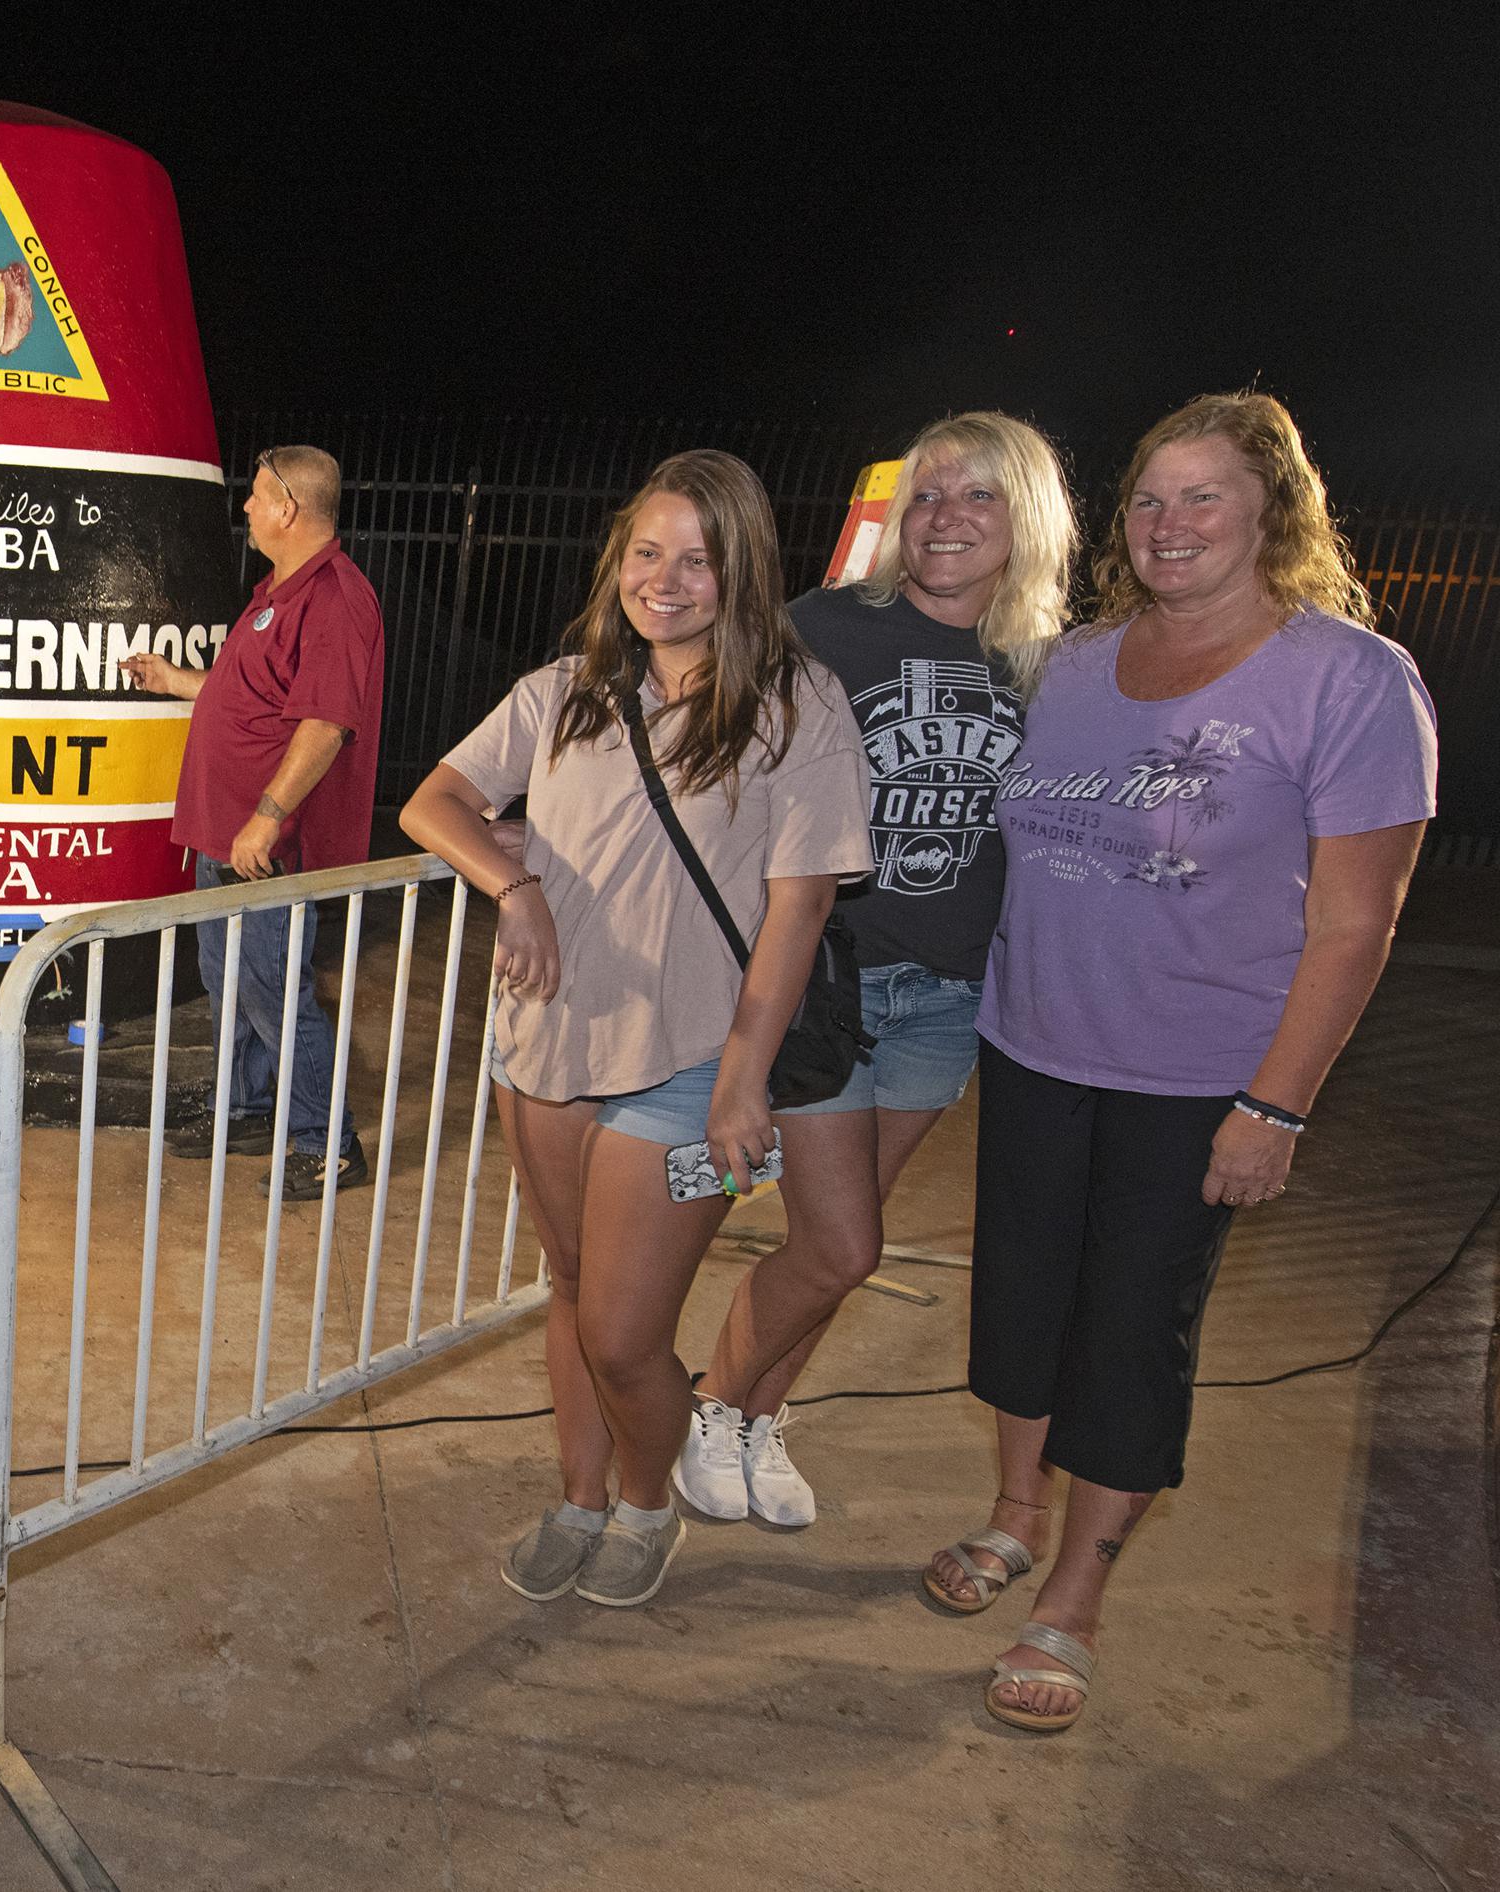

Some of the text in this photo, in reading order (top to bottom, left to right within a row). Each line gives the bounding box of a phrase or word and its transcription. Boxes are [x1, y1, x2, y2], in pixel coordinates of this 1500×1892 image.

[23, 236, 79, 337] CONCH
[75, 494, 102, 527] to
[1109, 763, 1210, 810] Keys
[1008, 815, 1150, 860] PARADISE FOUND
[1048, 858, 1090, 876] COASTAL
